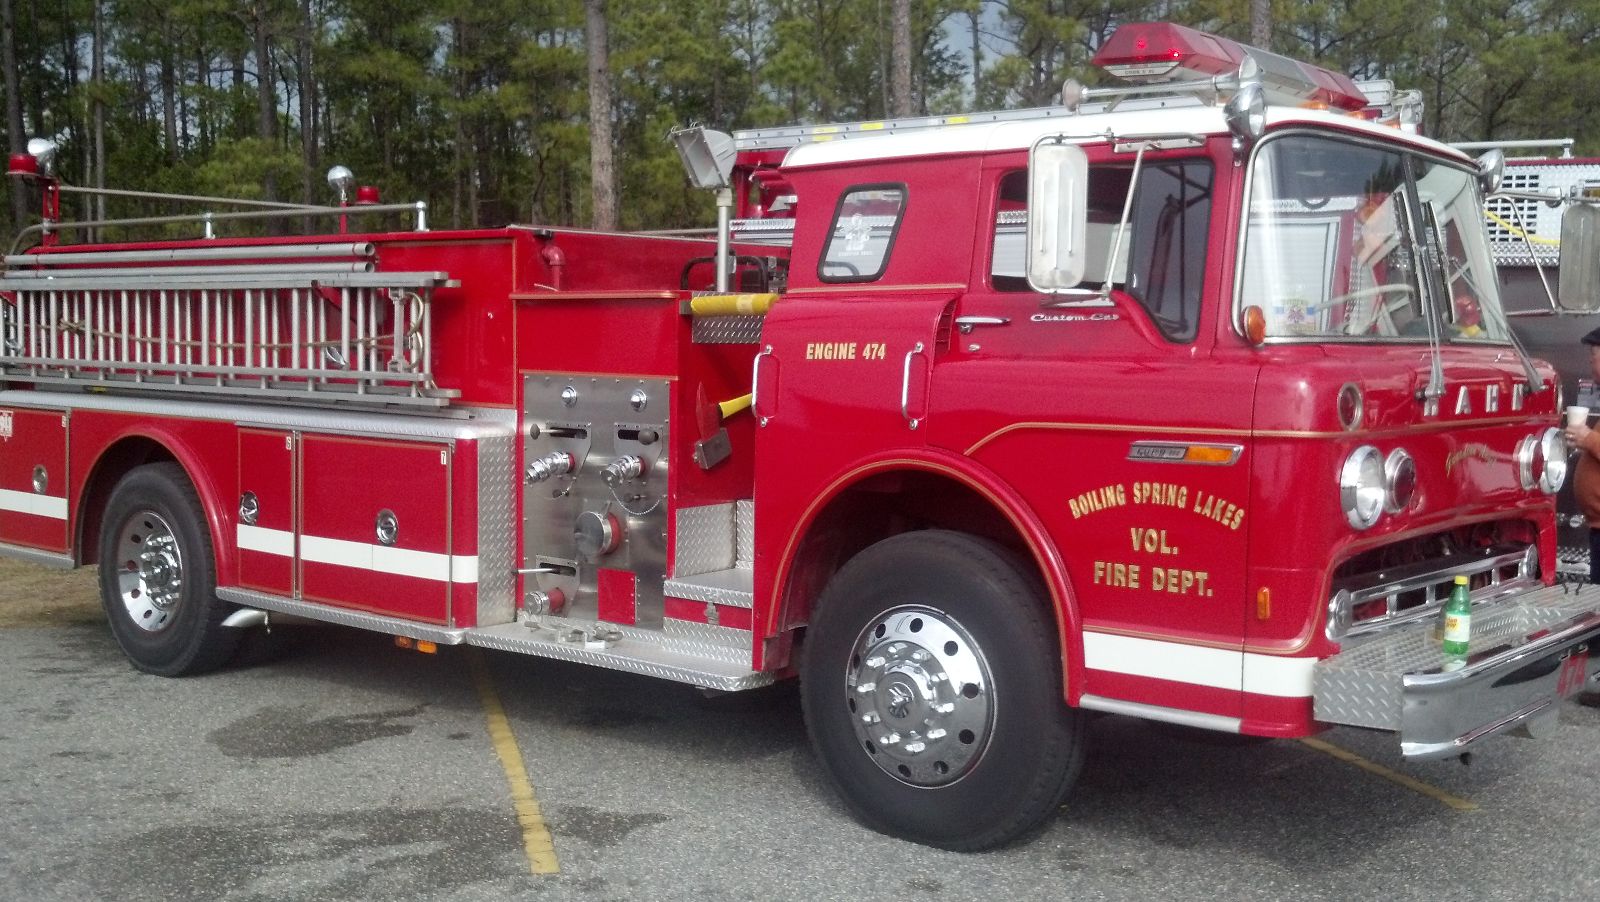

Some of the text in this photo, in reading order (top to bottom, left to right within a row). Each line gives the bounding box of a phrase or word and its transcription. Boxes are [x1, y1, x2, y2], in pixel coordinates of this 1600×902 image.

[1031, 313, 1084, 321] Custom
[806, 342, 886, 360] ENGINE 474
[1068, 482, 1245, 530] BOILING SPRING LAKES
[1131, 527, 1179, 555] VOL.
[1094, 561, 1213, 597] FIRE DEPT.
